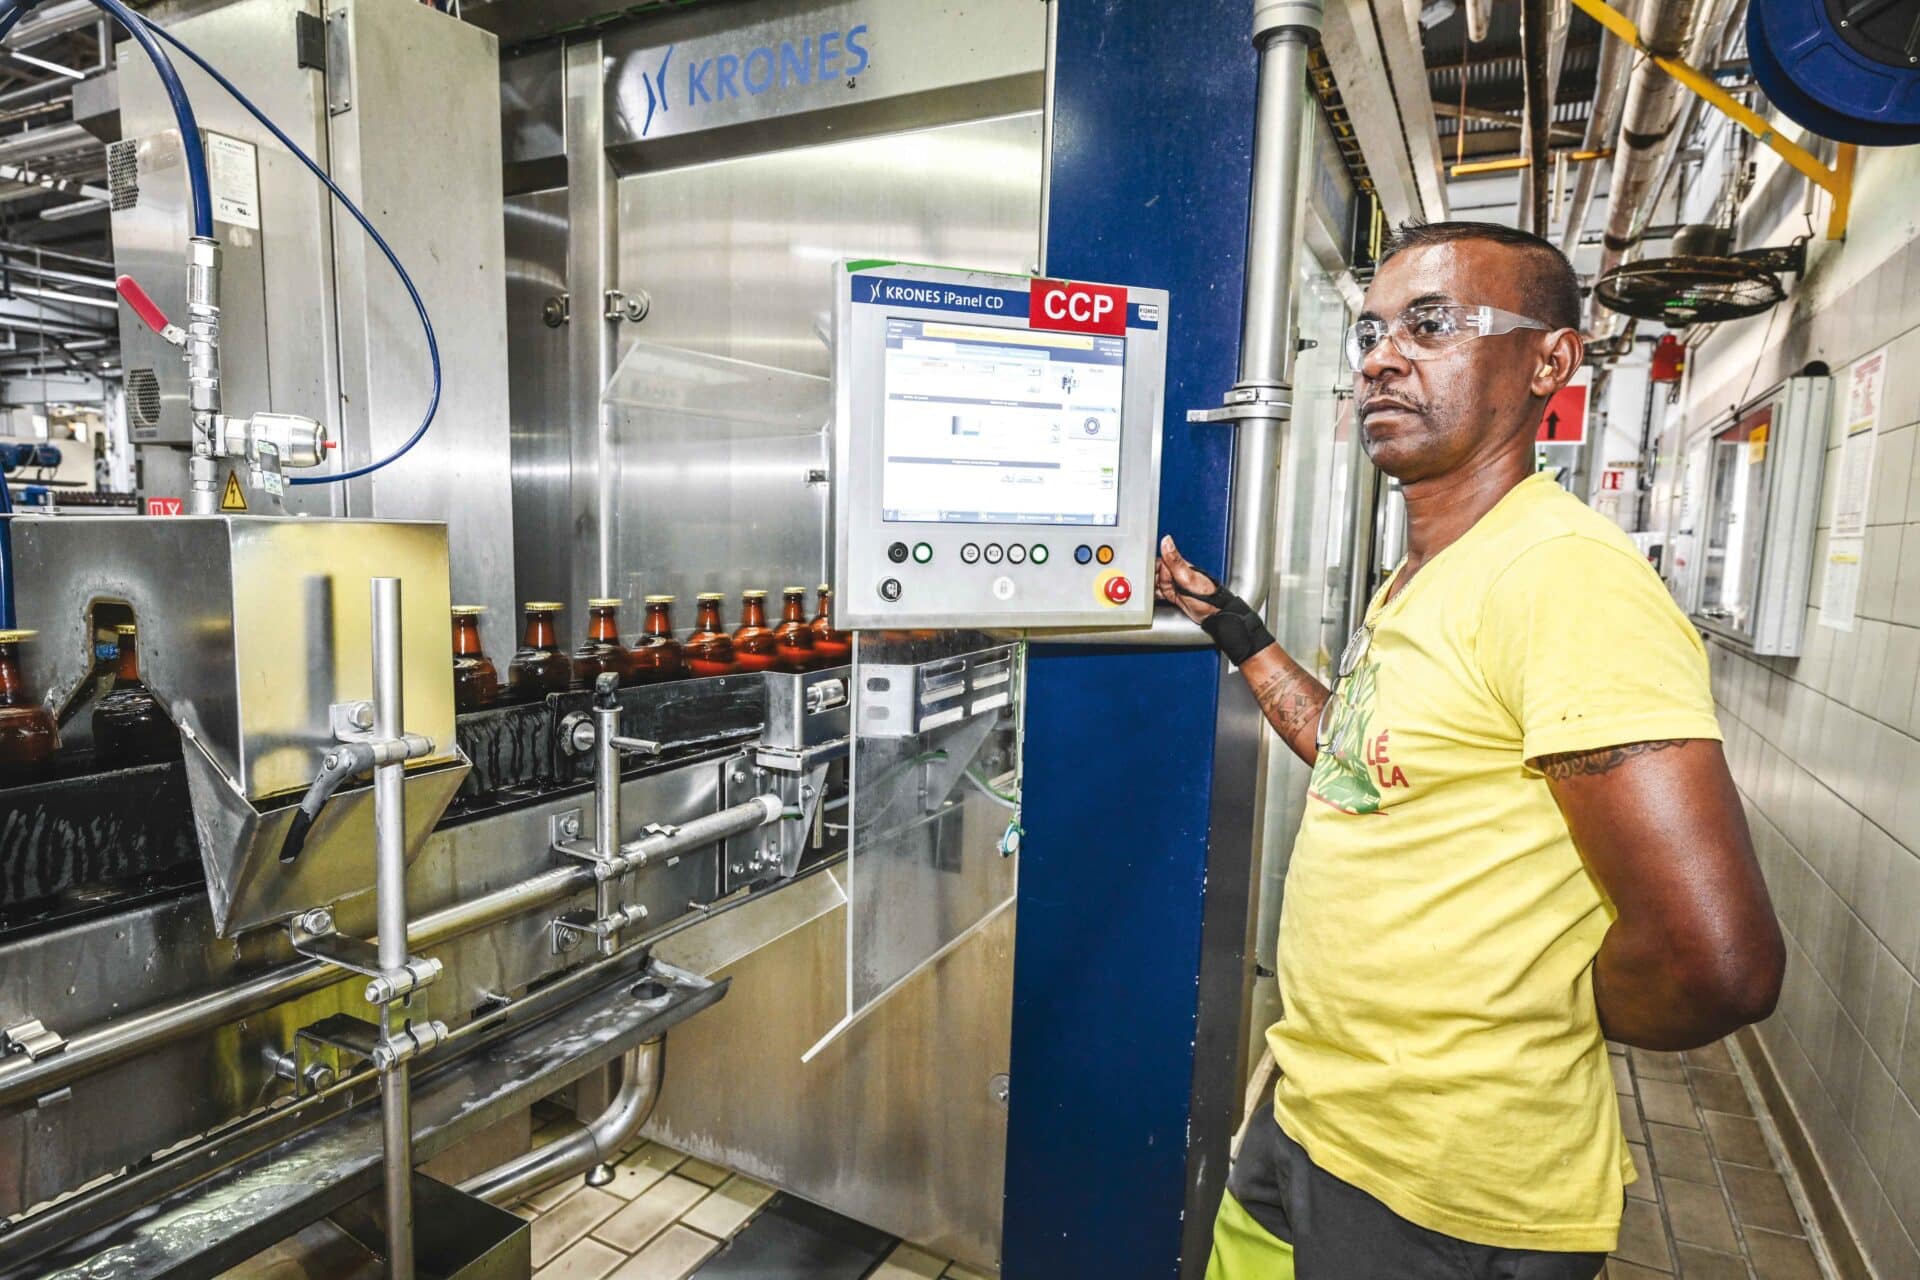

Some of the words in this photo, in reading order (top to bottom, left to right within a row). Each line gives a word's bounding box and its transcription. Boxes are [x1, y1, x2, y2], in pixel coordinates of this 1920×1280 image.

[688, 24, 869, 106] KRONES
[886, 286, 941, 304] KRONES
[944, 292, 982, 307] iPanel
[985, 296, 1004, 309] CD
[1044, 289, 1114, 323] CCP
[1377, 765, 1409, 788] LA
